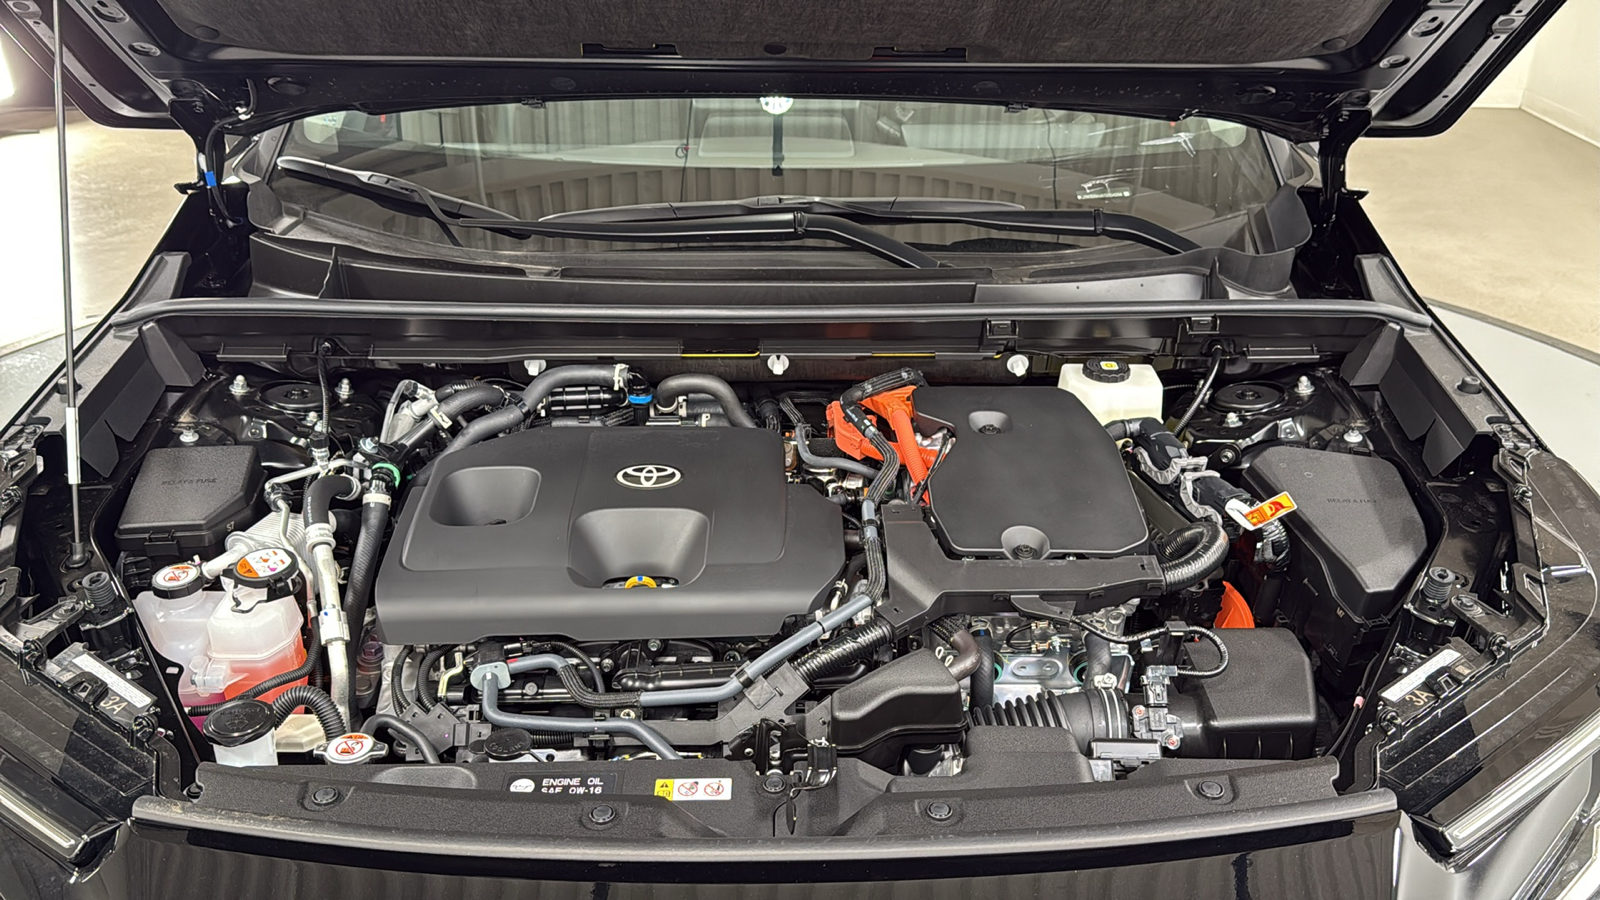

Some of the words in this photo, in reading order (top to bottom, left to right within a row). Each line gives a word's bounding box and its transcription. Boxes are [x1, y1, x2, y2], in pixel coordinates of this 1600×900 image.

[1405, 689, 1435, 706] 3A
[100, 696, 128, 714] 3A
[542, 778, 581, 786] ENGINE
[587, 777, 604, 785] OIL
[569, 786, 602, 794] 0W-16
